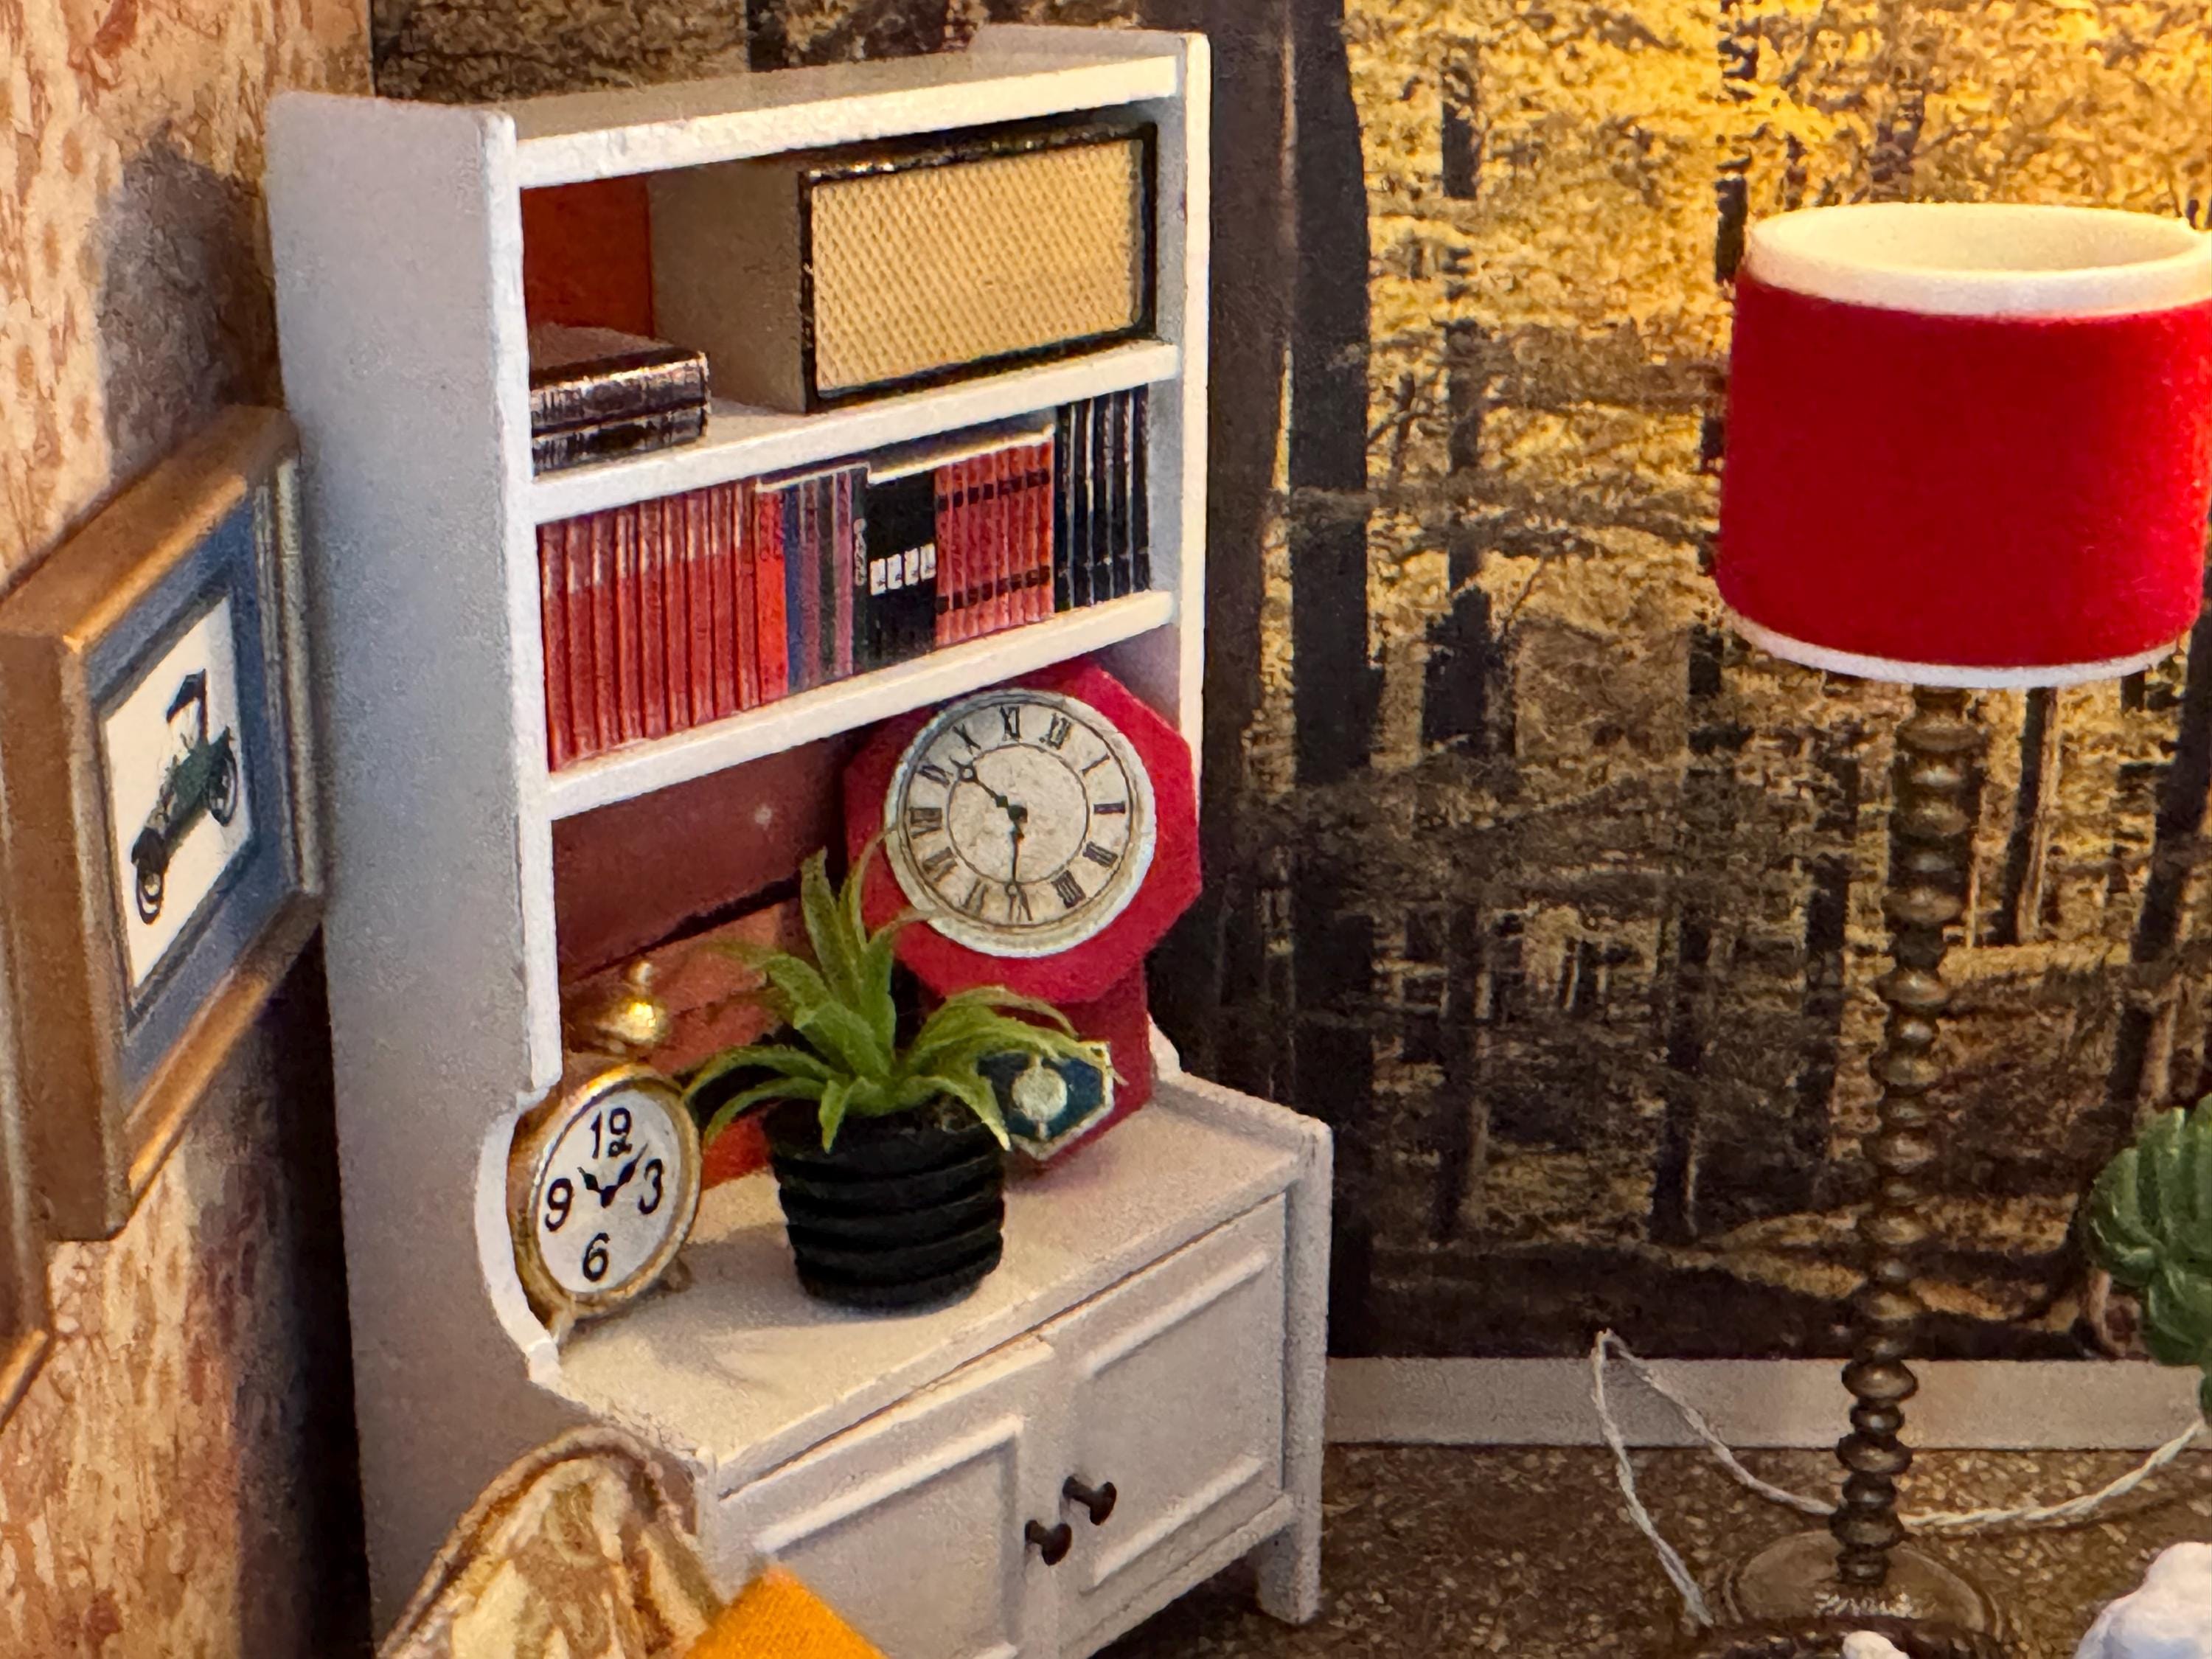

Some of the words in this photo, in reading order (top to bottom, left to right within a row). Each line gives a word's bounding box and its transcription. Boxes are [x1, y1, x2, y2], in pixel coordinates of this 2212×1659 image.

[591, 1107, 633, 1159] 12
[545, 1178, 573, 1231] 9
[639, 1158, 664, 1215] 3
[582, 1233, 609, 1282] 6
